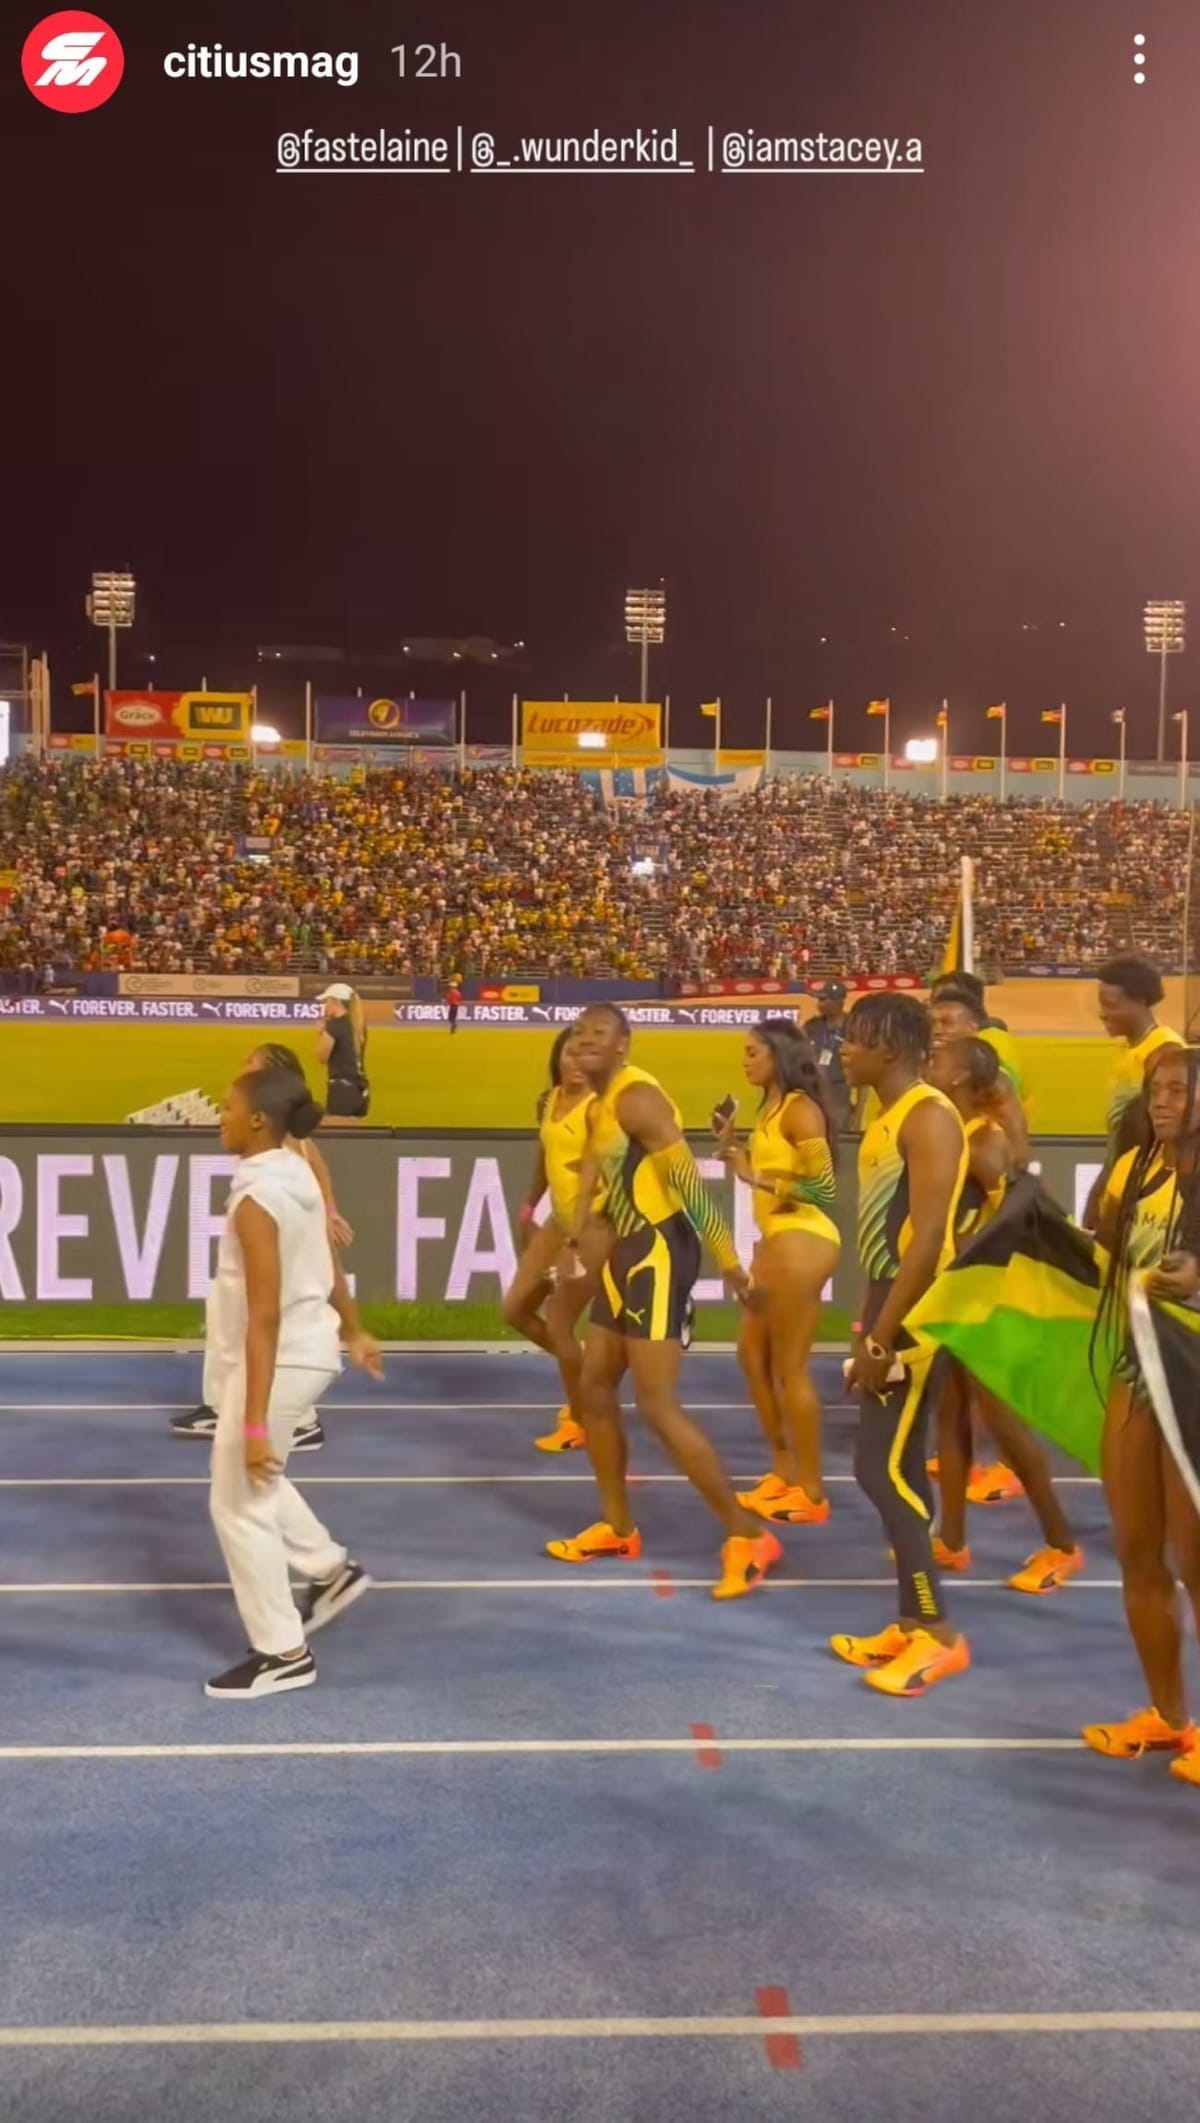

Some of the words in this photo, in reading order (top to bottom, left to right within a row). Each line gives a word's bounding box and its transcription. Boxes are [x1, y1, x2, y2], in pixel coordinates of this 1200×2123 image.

[527, 711, 637, 735] Lucozade
[72, 1000, 139, 1016] FOREVER.
[142, 1001, 198, 1017] FASTER.
[225, 1002, 292, 1018] FOREVER.
[473, 1005, 529, 1021] FASTER.
